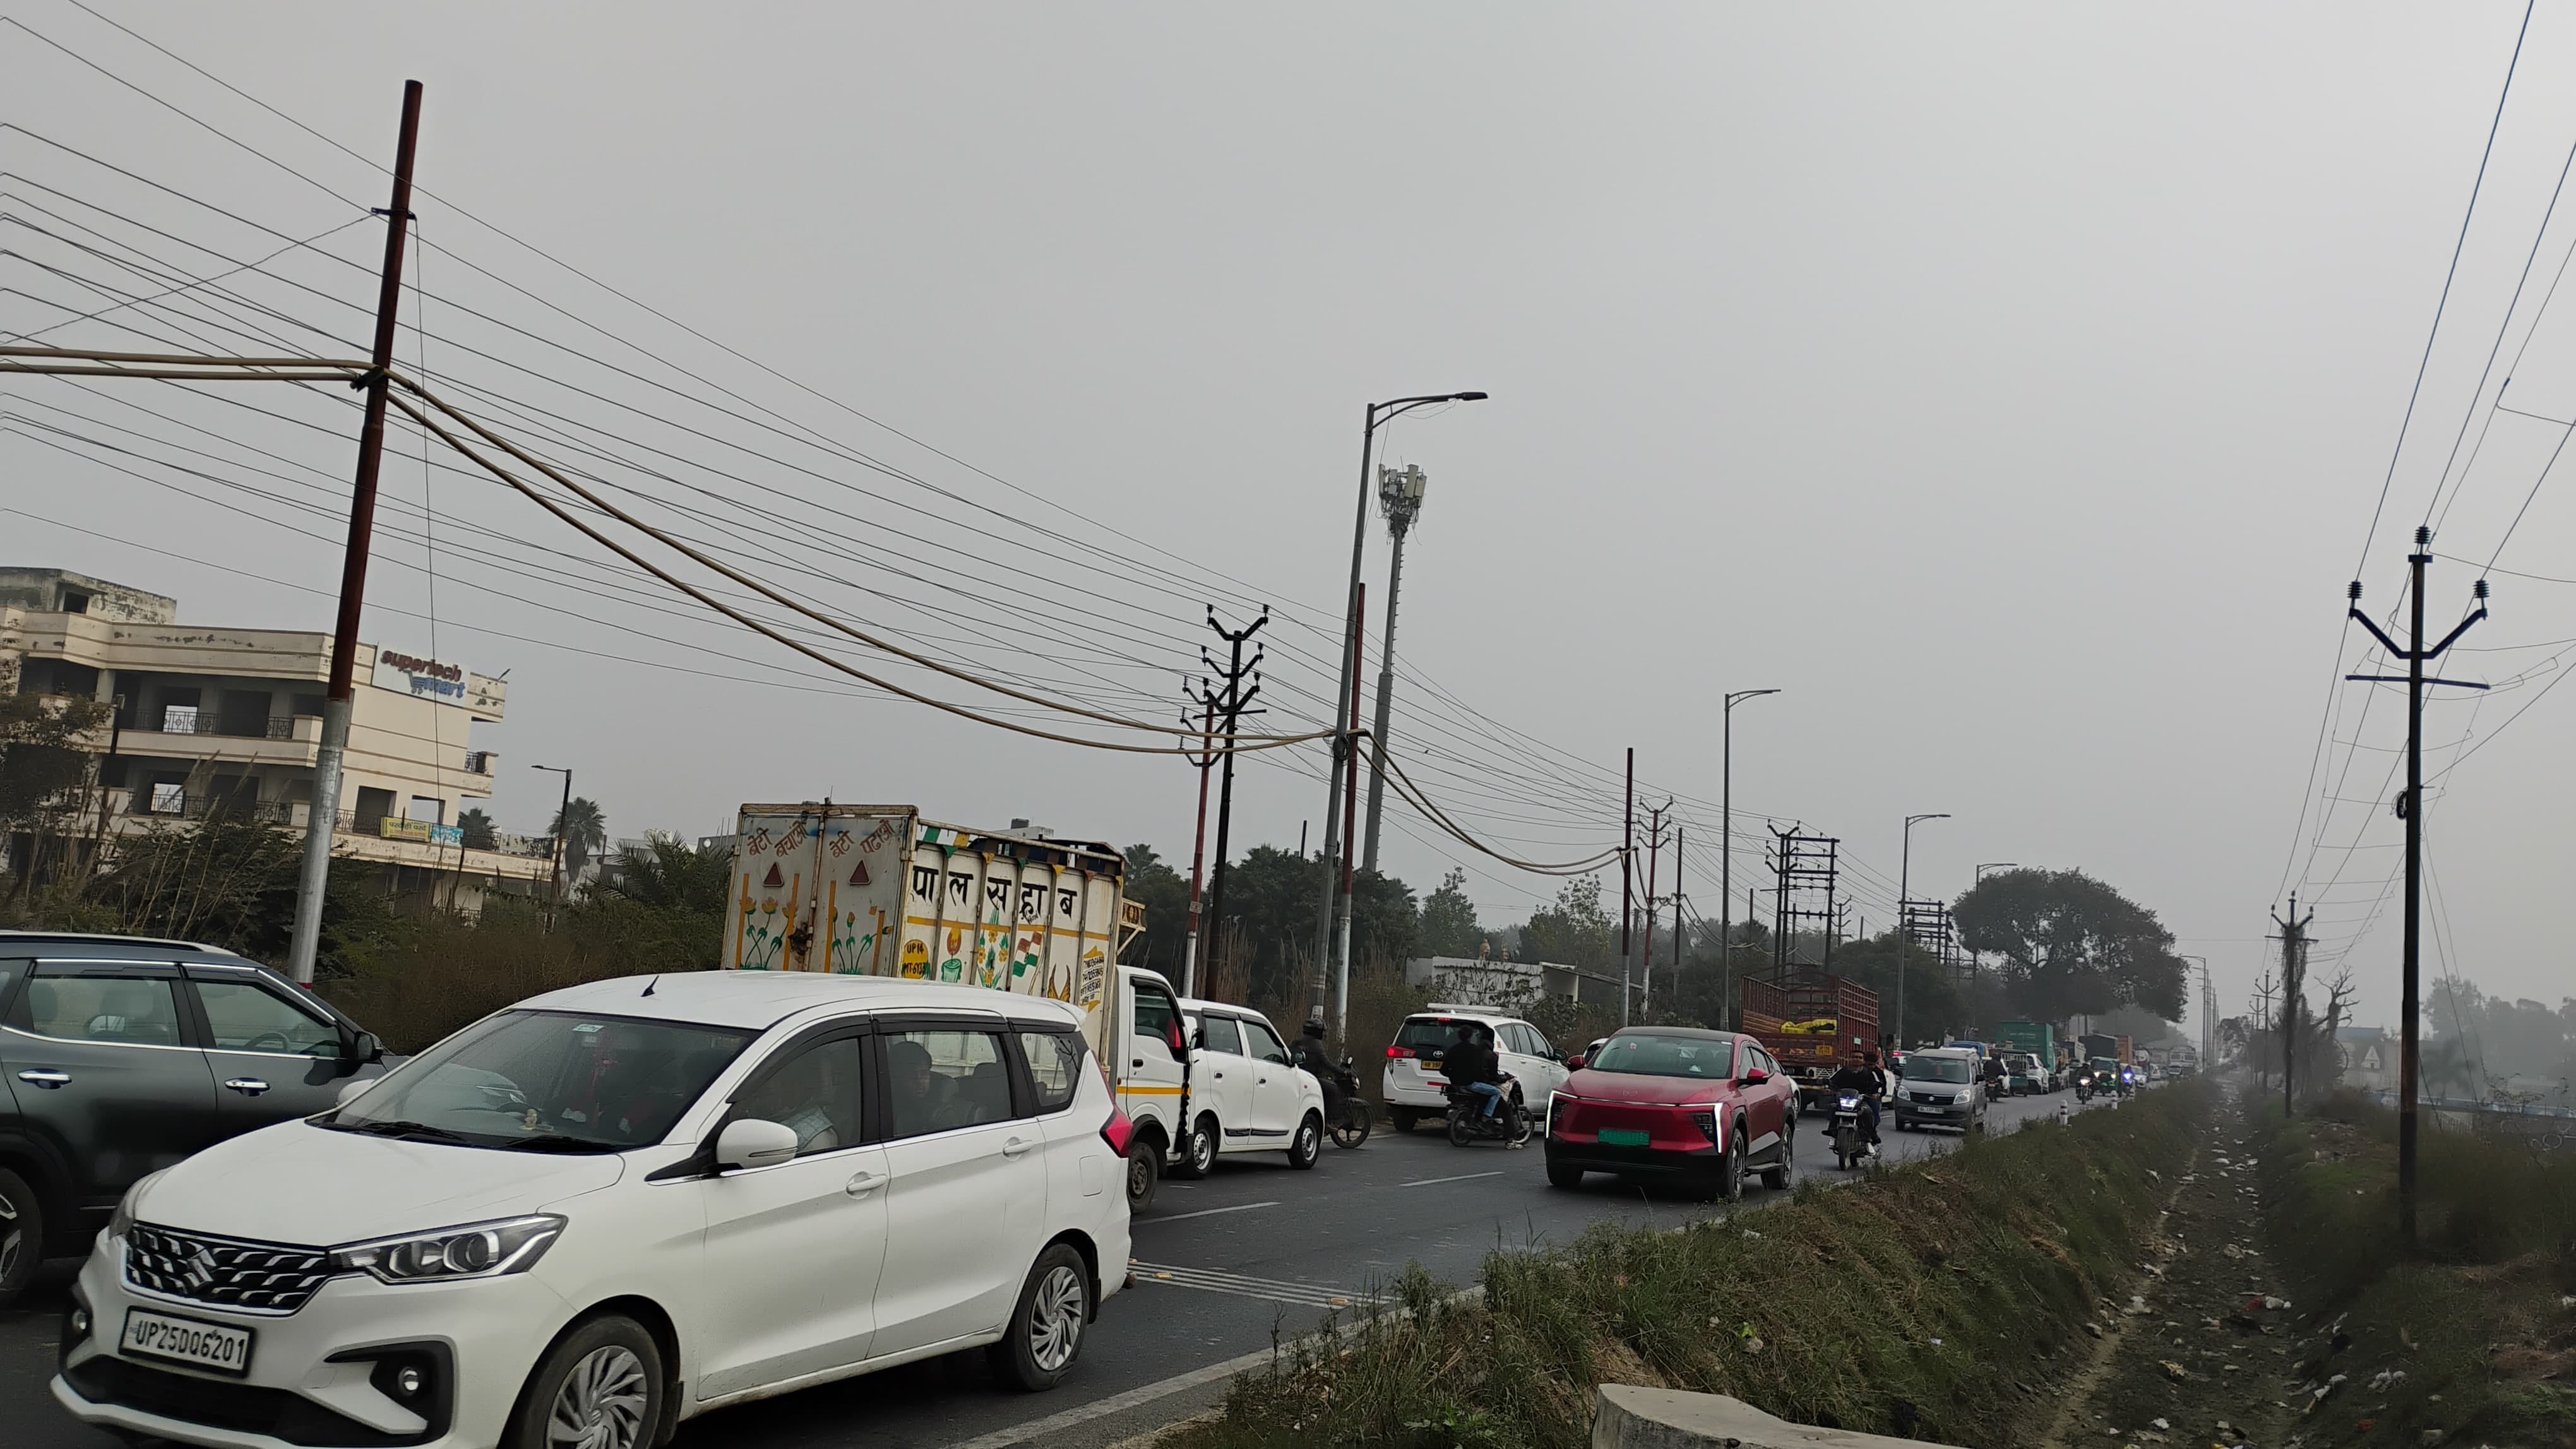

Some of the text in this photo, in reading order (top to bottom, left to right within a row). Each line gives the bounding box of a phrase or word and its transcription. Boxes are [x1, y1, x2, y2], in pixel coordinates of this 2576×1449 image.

[381, 650, 462, 682] supertech
[424, 677, 465, 698] mart
[747, 827, 773, 856] बेटी
[829, 830, 855, 858] बेटी
